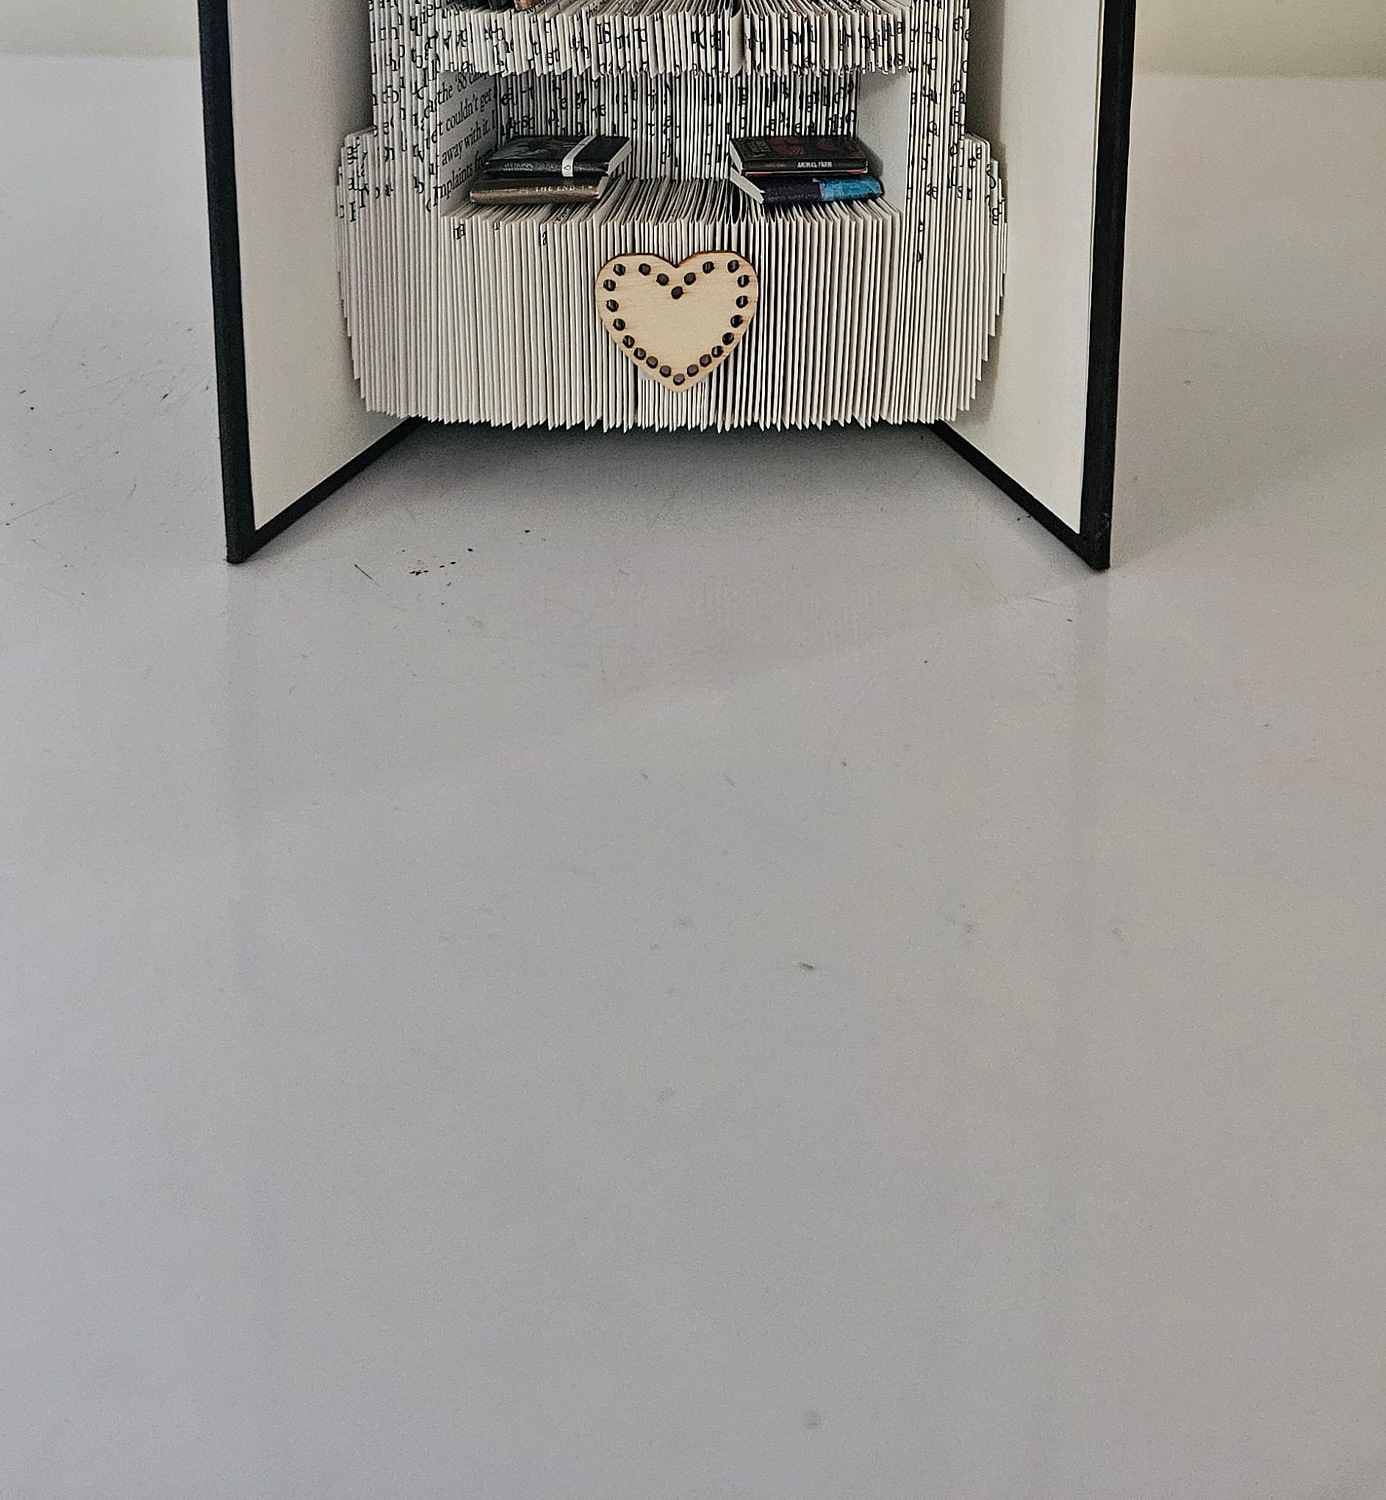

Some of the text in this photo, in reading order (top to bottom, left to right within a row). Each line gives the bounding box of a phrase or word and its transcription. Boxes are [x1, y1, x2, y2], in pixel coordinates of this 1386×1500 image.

[437, 82, 453, 105] the
[445, 93, 479, 132] couldn't
[479, 88, 493, 113] get
[441, 140, 463, 166] away
[464, 122, 482, 149] with
